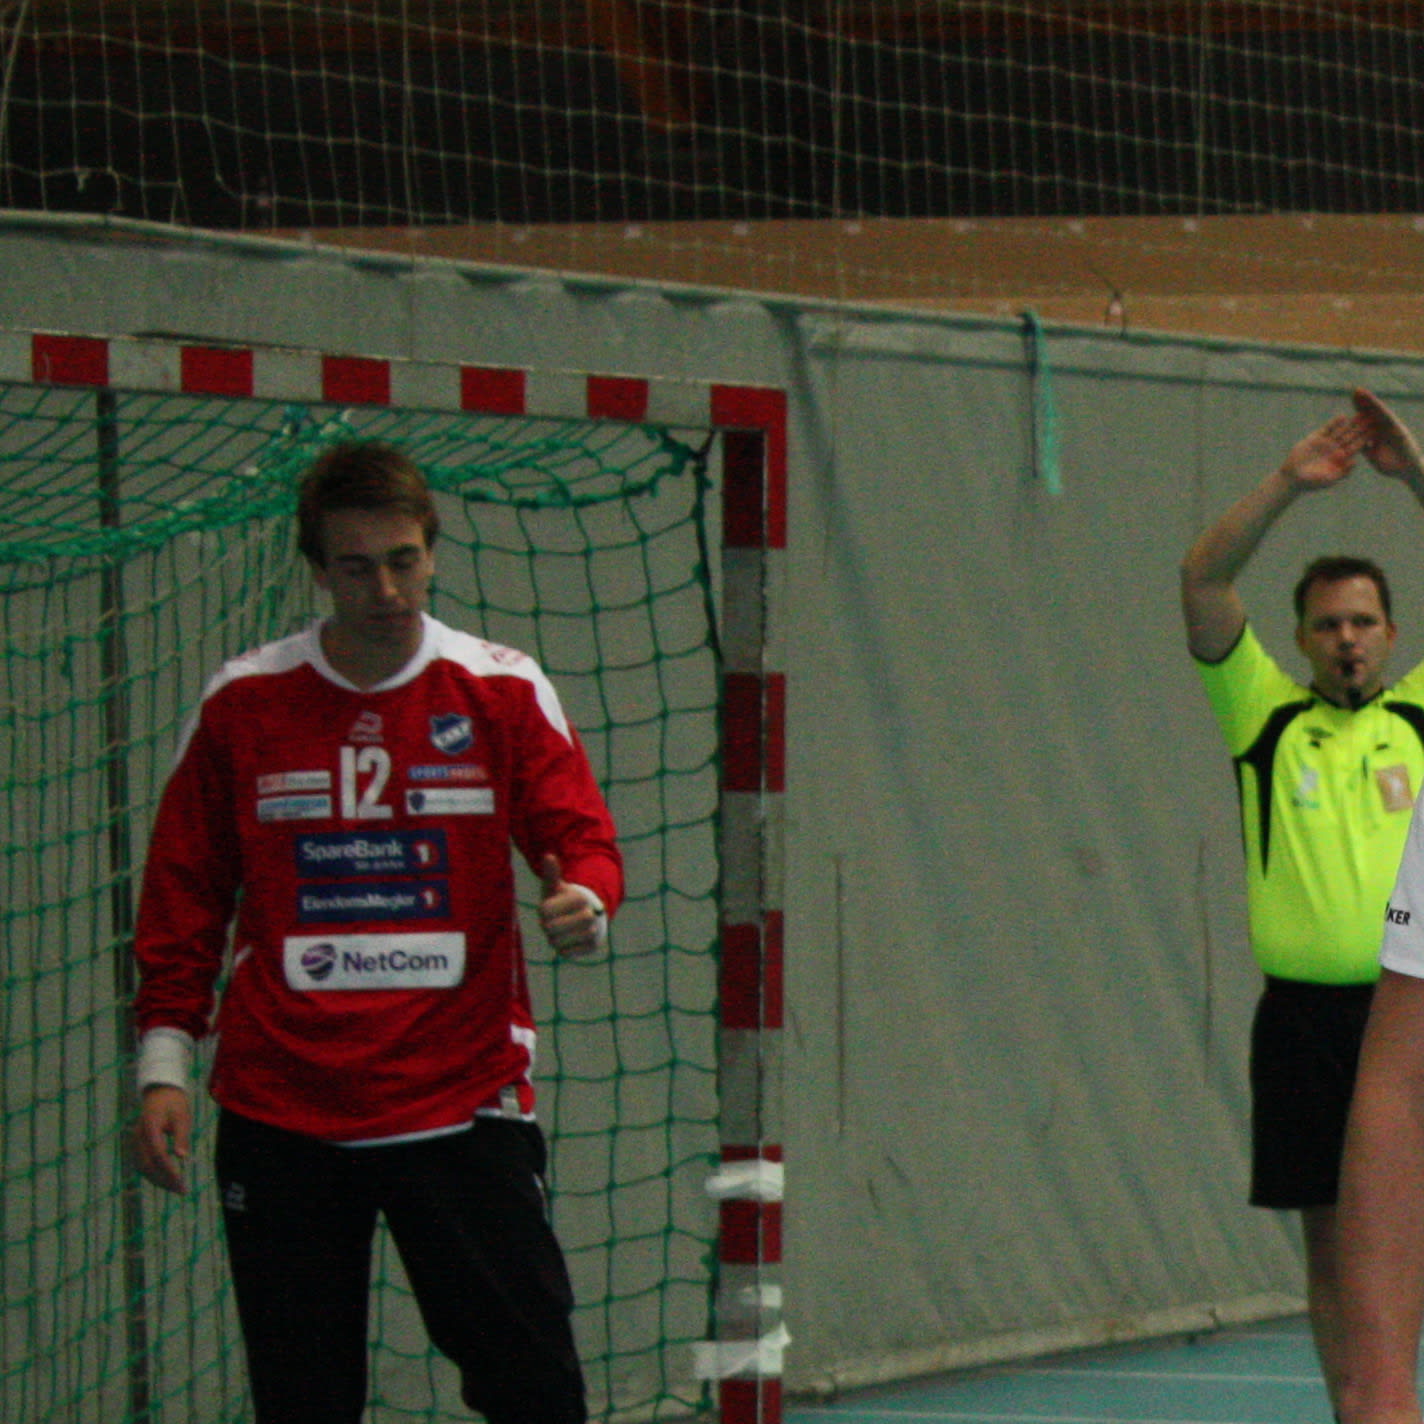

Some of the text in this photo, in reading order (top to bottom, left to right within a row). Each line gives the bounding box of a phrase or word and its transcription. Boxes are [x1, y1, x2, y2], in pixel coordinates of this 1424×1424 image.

[340, 746, 393, 819] 12
[302, 840, 430, 864] SpareBank 1
[343, 951, 448, 972] NetCom
